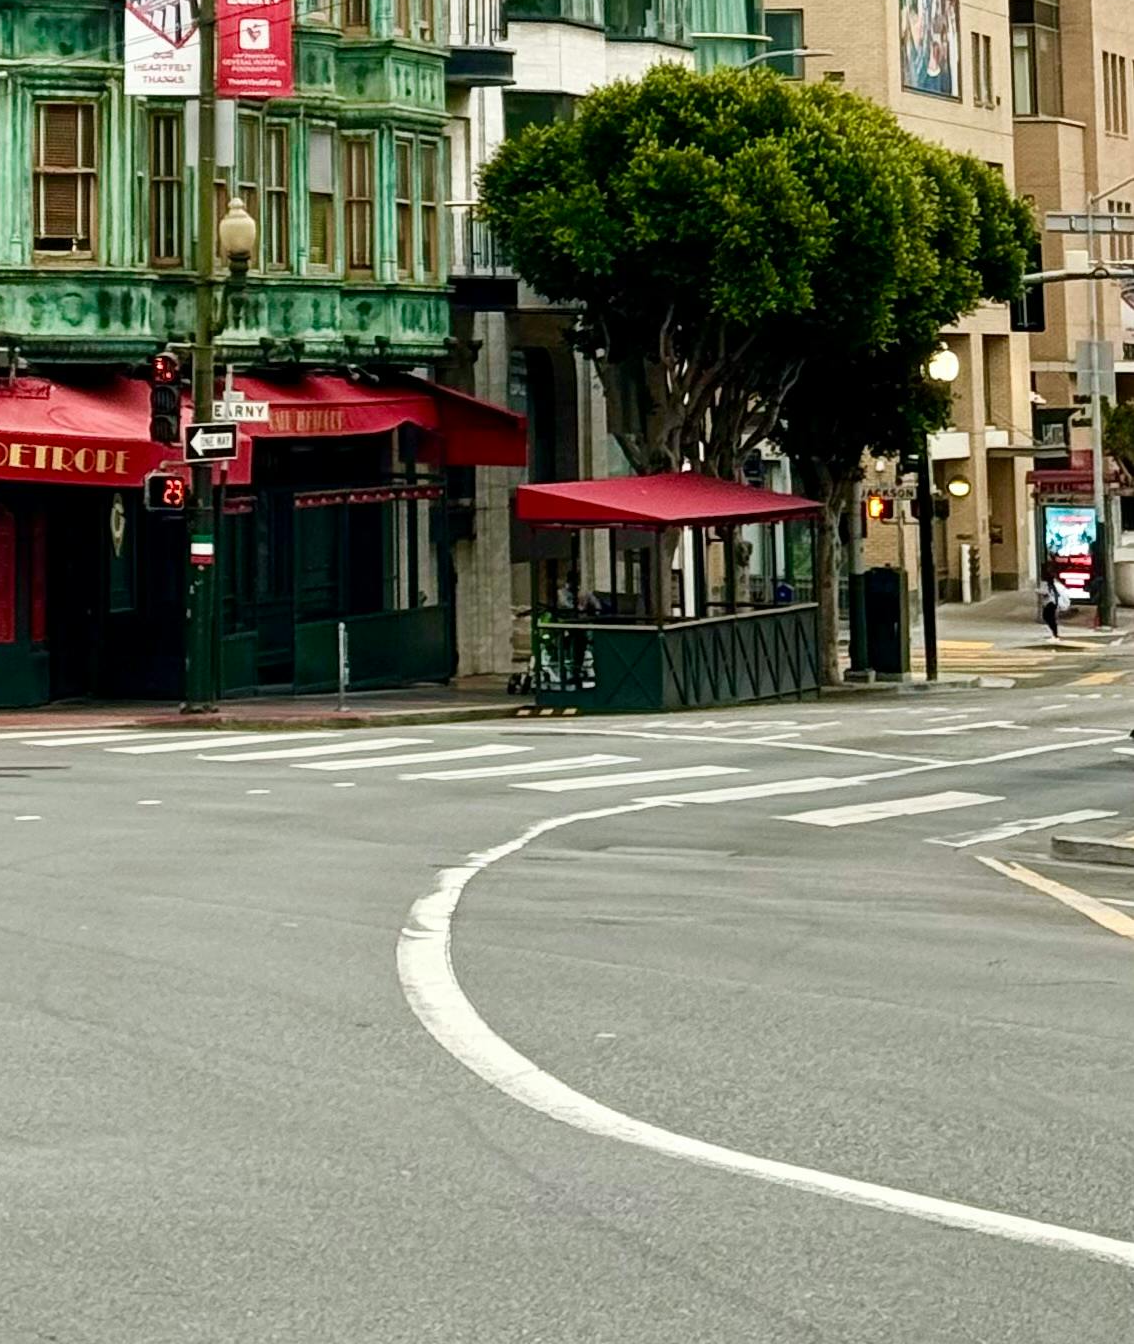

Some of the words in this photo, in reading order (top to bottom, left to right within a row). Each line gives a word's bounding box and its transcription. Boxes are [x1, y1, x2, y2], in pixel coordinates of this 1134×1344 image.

[133, 63, 192, 72] HEARTFELT
[142, 75, 185, 84] THANKS
[163, 479, 183, 505] 23
[861, 488, 914, 498] JACKSON
